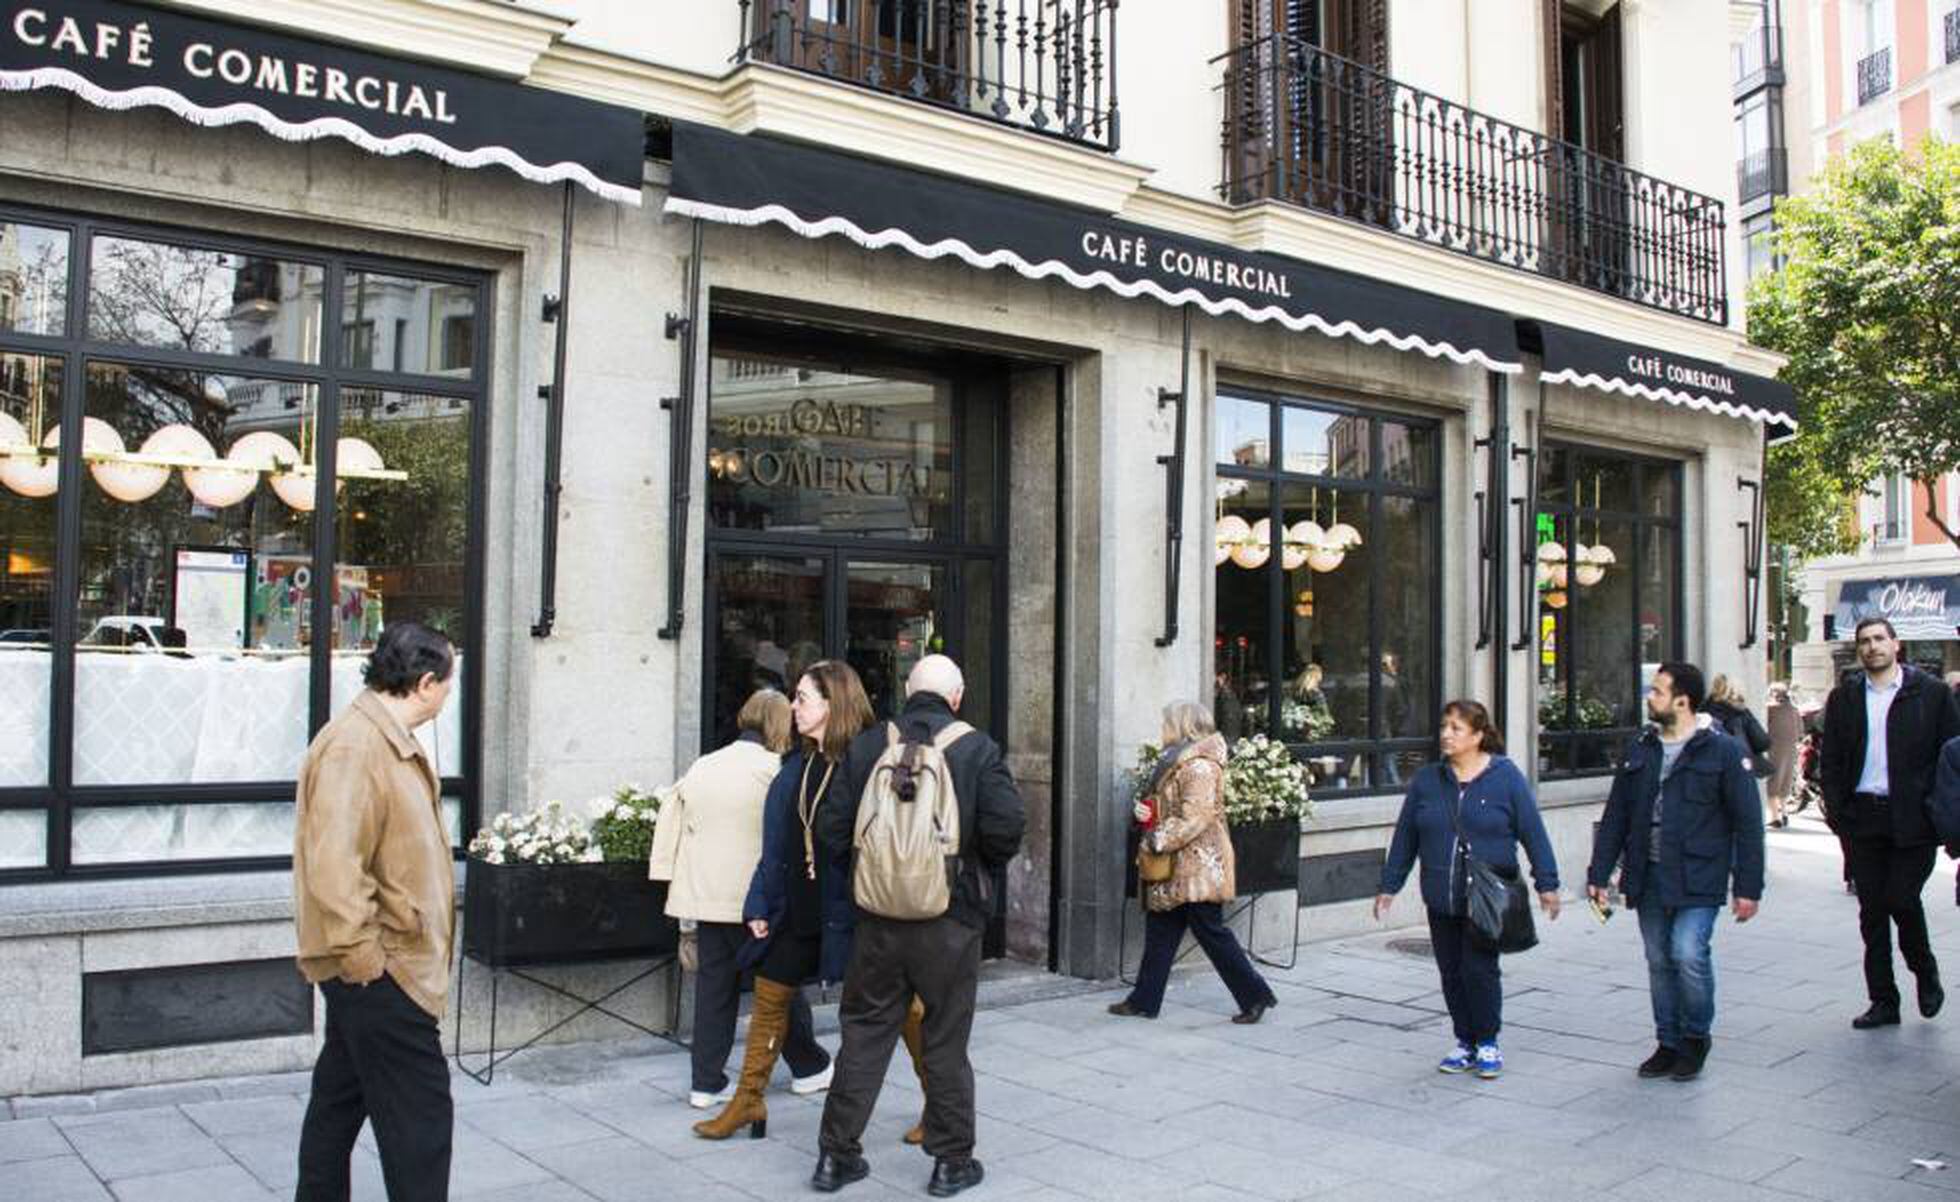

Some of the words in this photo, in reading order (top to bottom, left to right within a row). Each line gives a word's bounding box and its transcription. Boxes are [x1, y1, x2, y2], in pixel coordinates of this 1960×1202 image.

[13, 8, 154, 68] CAFÉ
[183, 43, 457, 124] COMERCIAL
[1081, 231, 1147, 267] CAFÉ
[1160, 249, 1292, 298] COMERCIAL
[1627, 355, 1663, 379] CAFÉ
[1666, 363, 1735, 395] COMERCIAL
[727, 447, 934, 498] COMERCIAL
